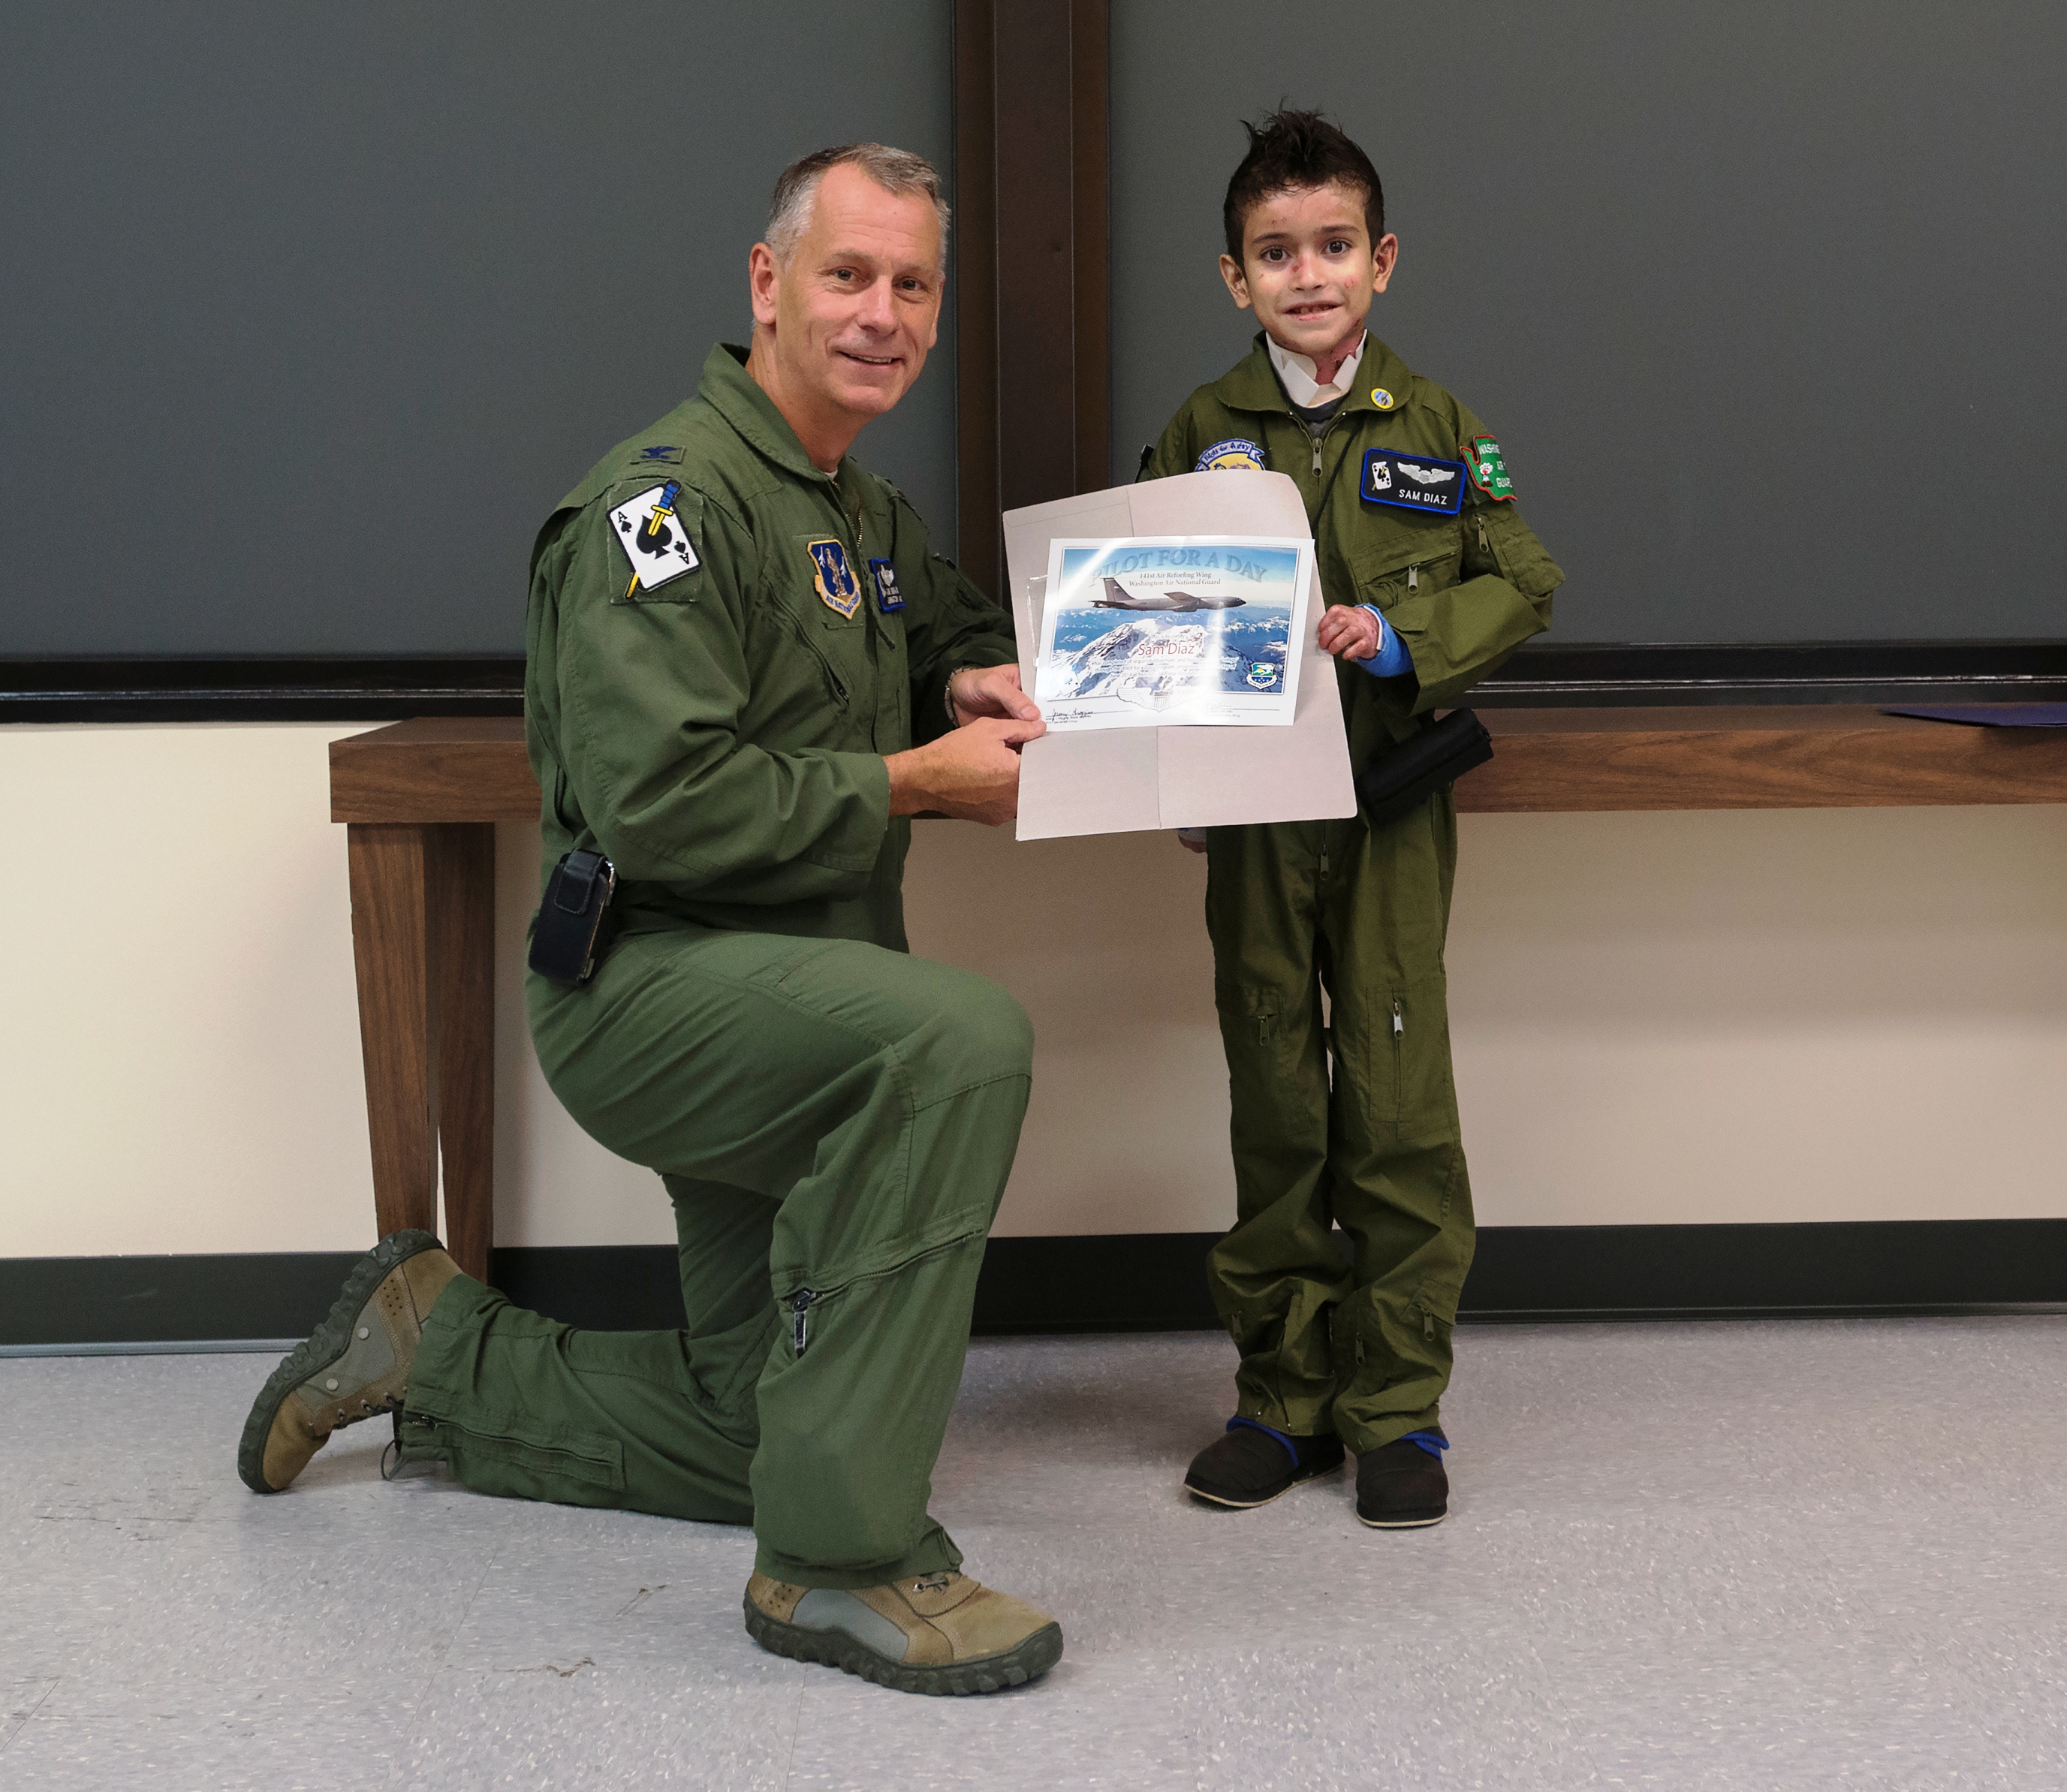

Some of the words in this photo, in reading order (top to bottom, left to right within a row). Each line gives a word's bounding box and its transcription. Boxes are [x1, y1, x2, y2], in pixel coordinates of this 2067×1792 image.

[1398, 489, 1421, 501] SAM
[1424, 492, 1448, 505] DIAZ
[617, 510, 628, 523] A
[678, 552, 690, 565] A
[1089, 550, 1153, 588] PILOT
[1156, 549, 1201, 566] FOR
[1204, 550, 1220, 568] A
[1224, 554, 1267, 583] DAY
[1138, 643, 1165, 655] Sam
[1168, 643, 1195, 655] Diaz
